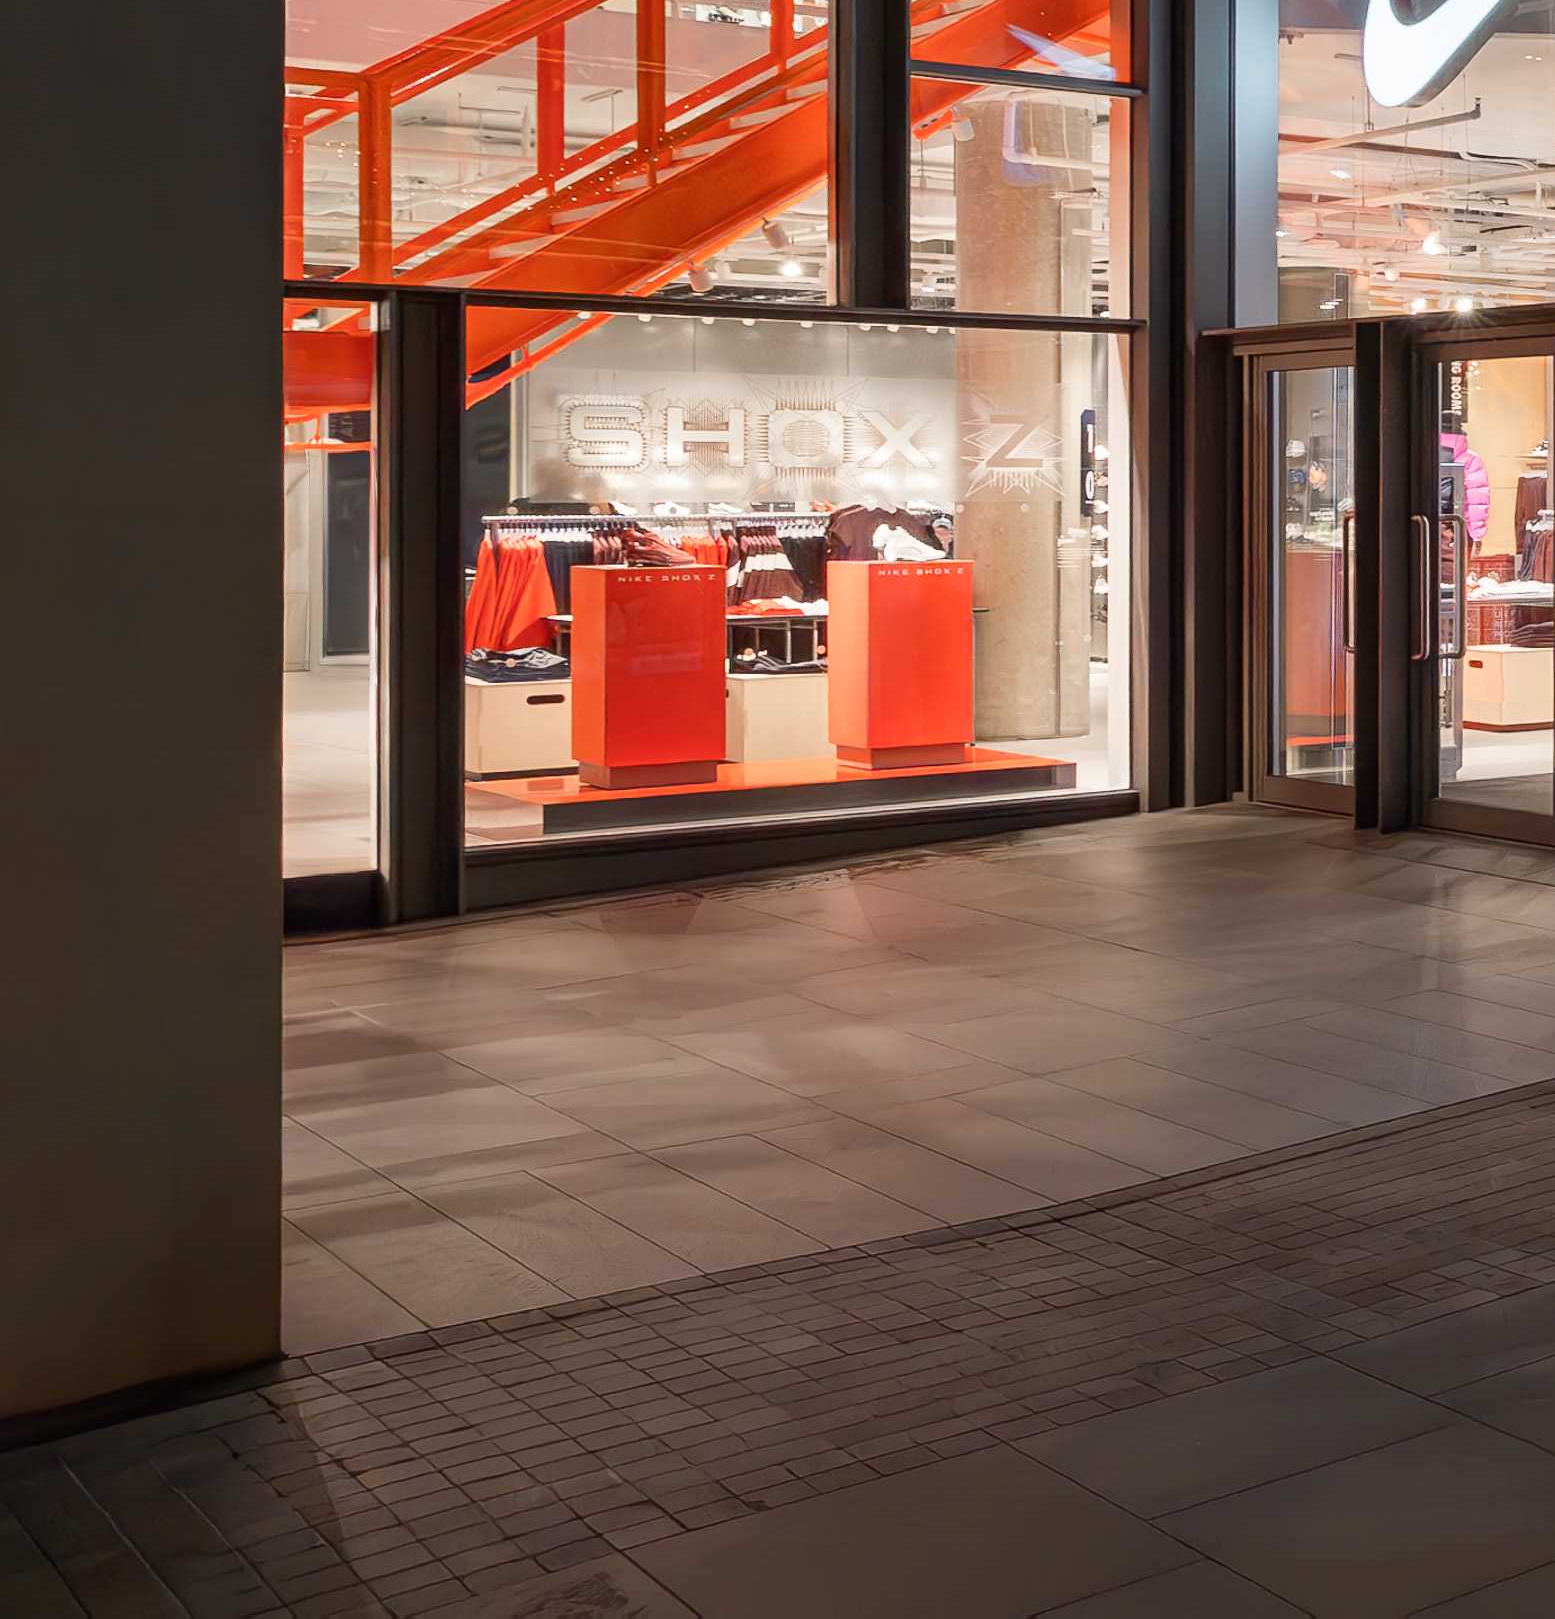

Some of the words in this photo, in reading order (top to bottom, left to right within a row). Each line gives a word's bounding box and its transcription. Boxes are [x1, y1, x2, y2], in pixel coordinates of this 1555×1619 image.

[566, 403, 935, 470] SHOX
[986, 413, 1044, 469] Z
[878, 568, 910, 576] NIKE
[618, 575, 653, 583] NIKE
[661, 573, 701, 582] SHOX
